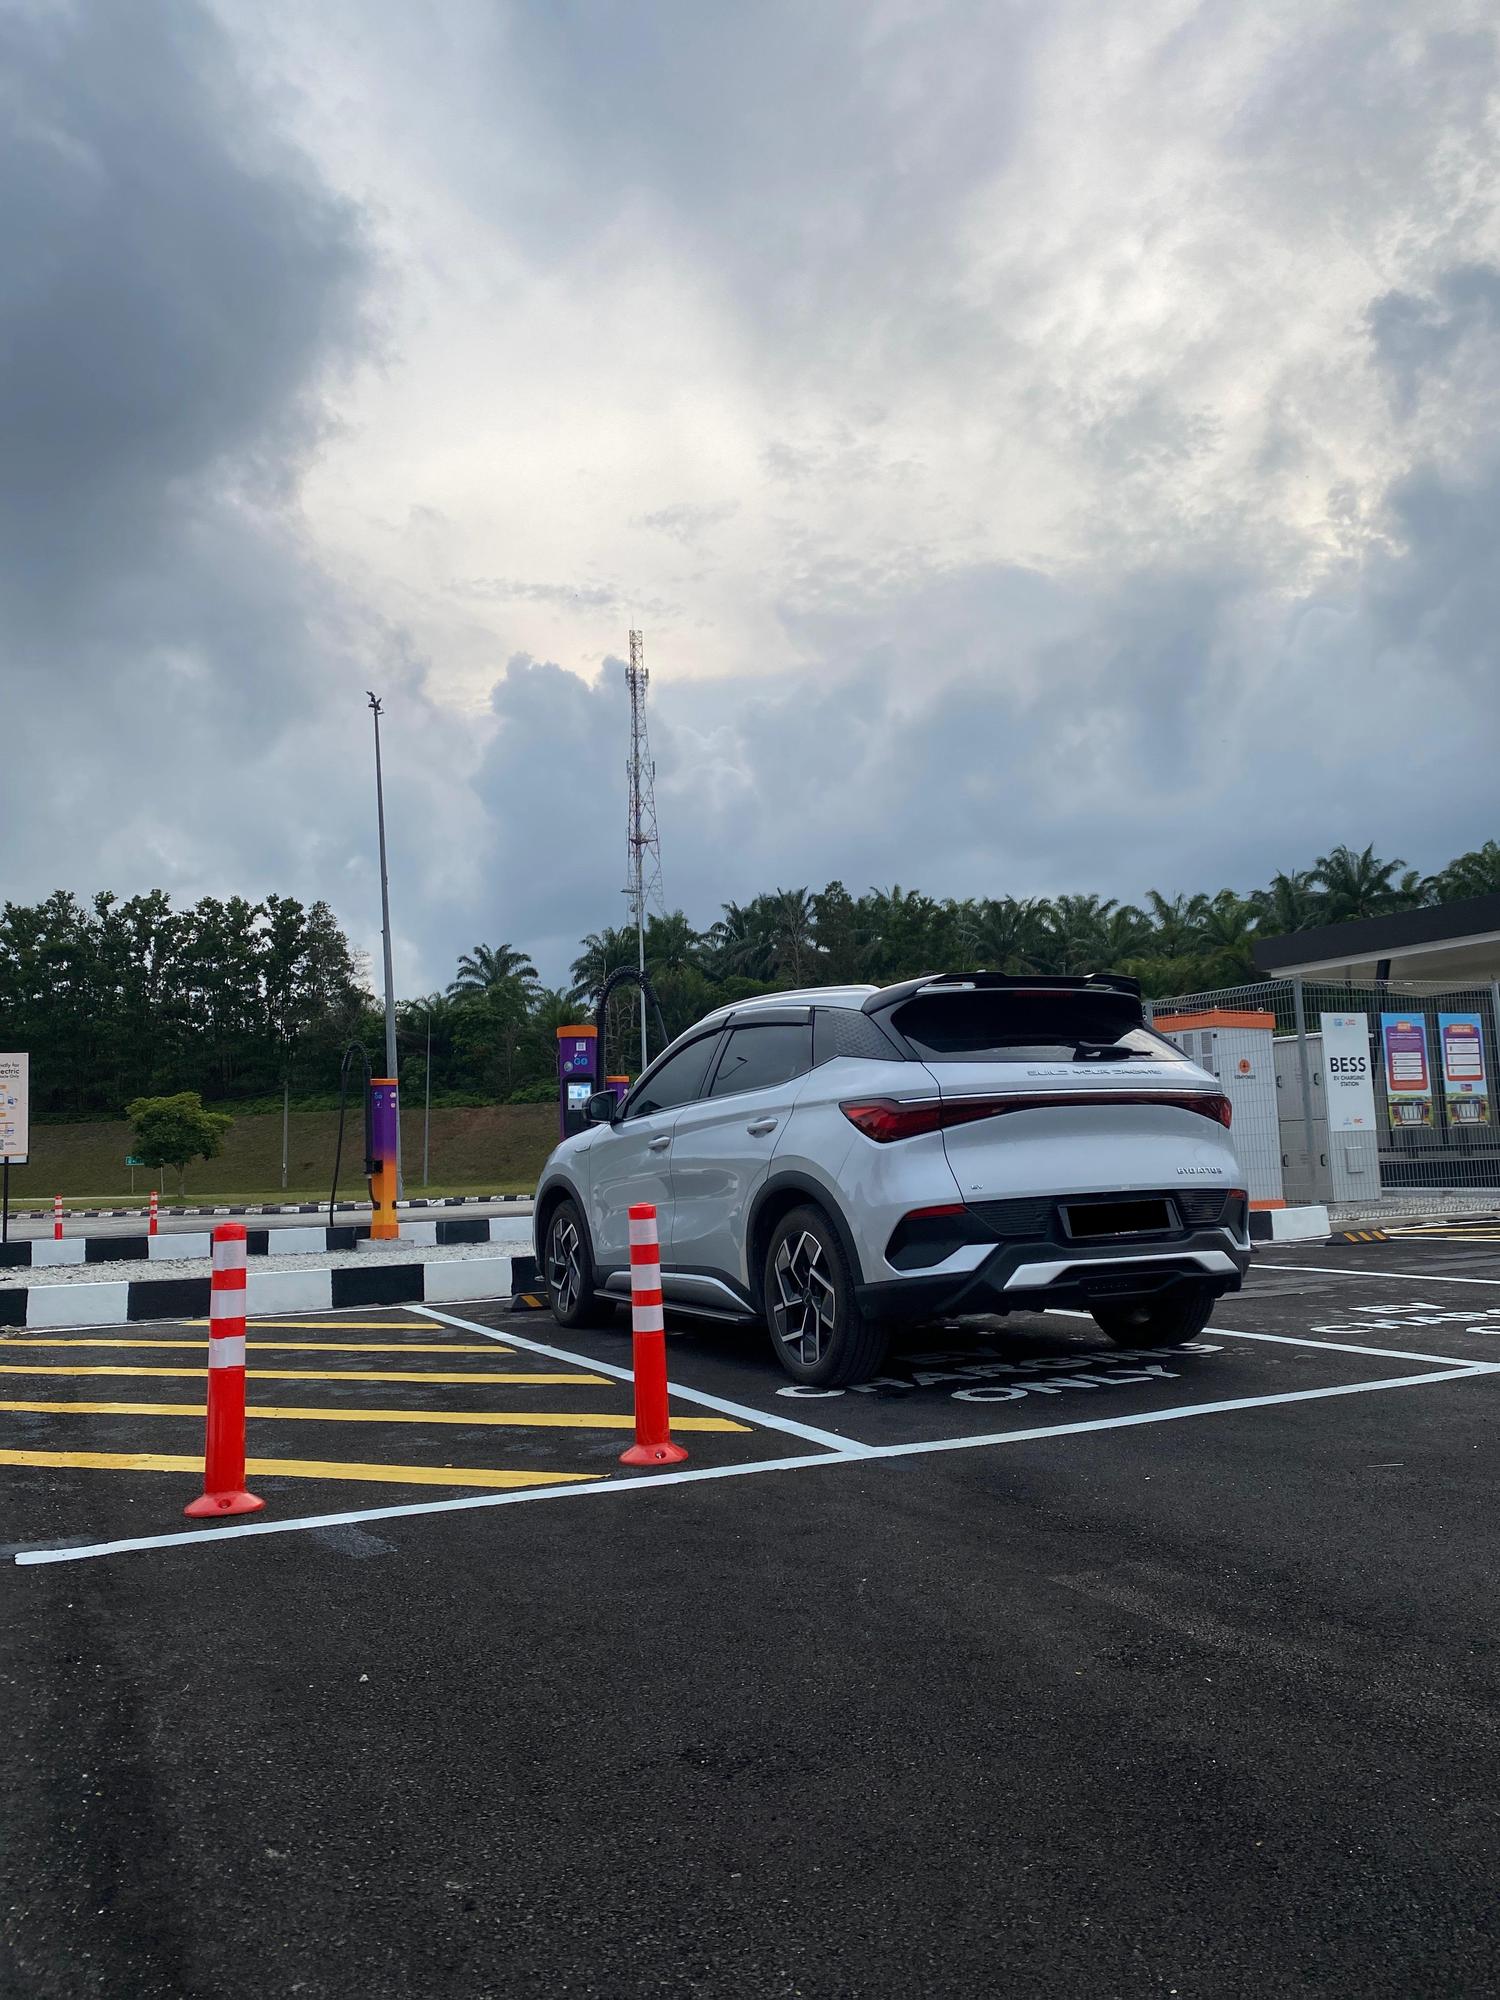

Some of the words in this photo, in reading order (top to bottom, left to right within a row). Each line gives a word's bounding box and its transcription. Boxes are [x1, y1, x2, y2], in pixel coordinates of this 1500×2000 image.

[1329, 1056, 1367, 1073] BESS
[1176, 1167, 1196, 1175] BYD
[1348, 1301, 1446, 1314] EV
[950, 1364, 1182, 1403] ONLY
